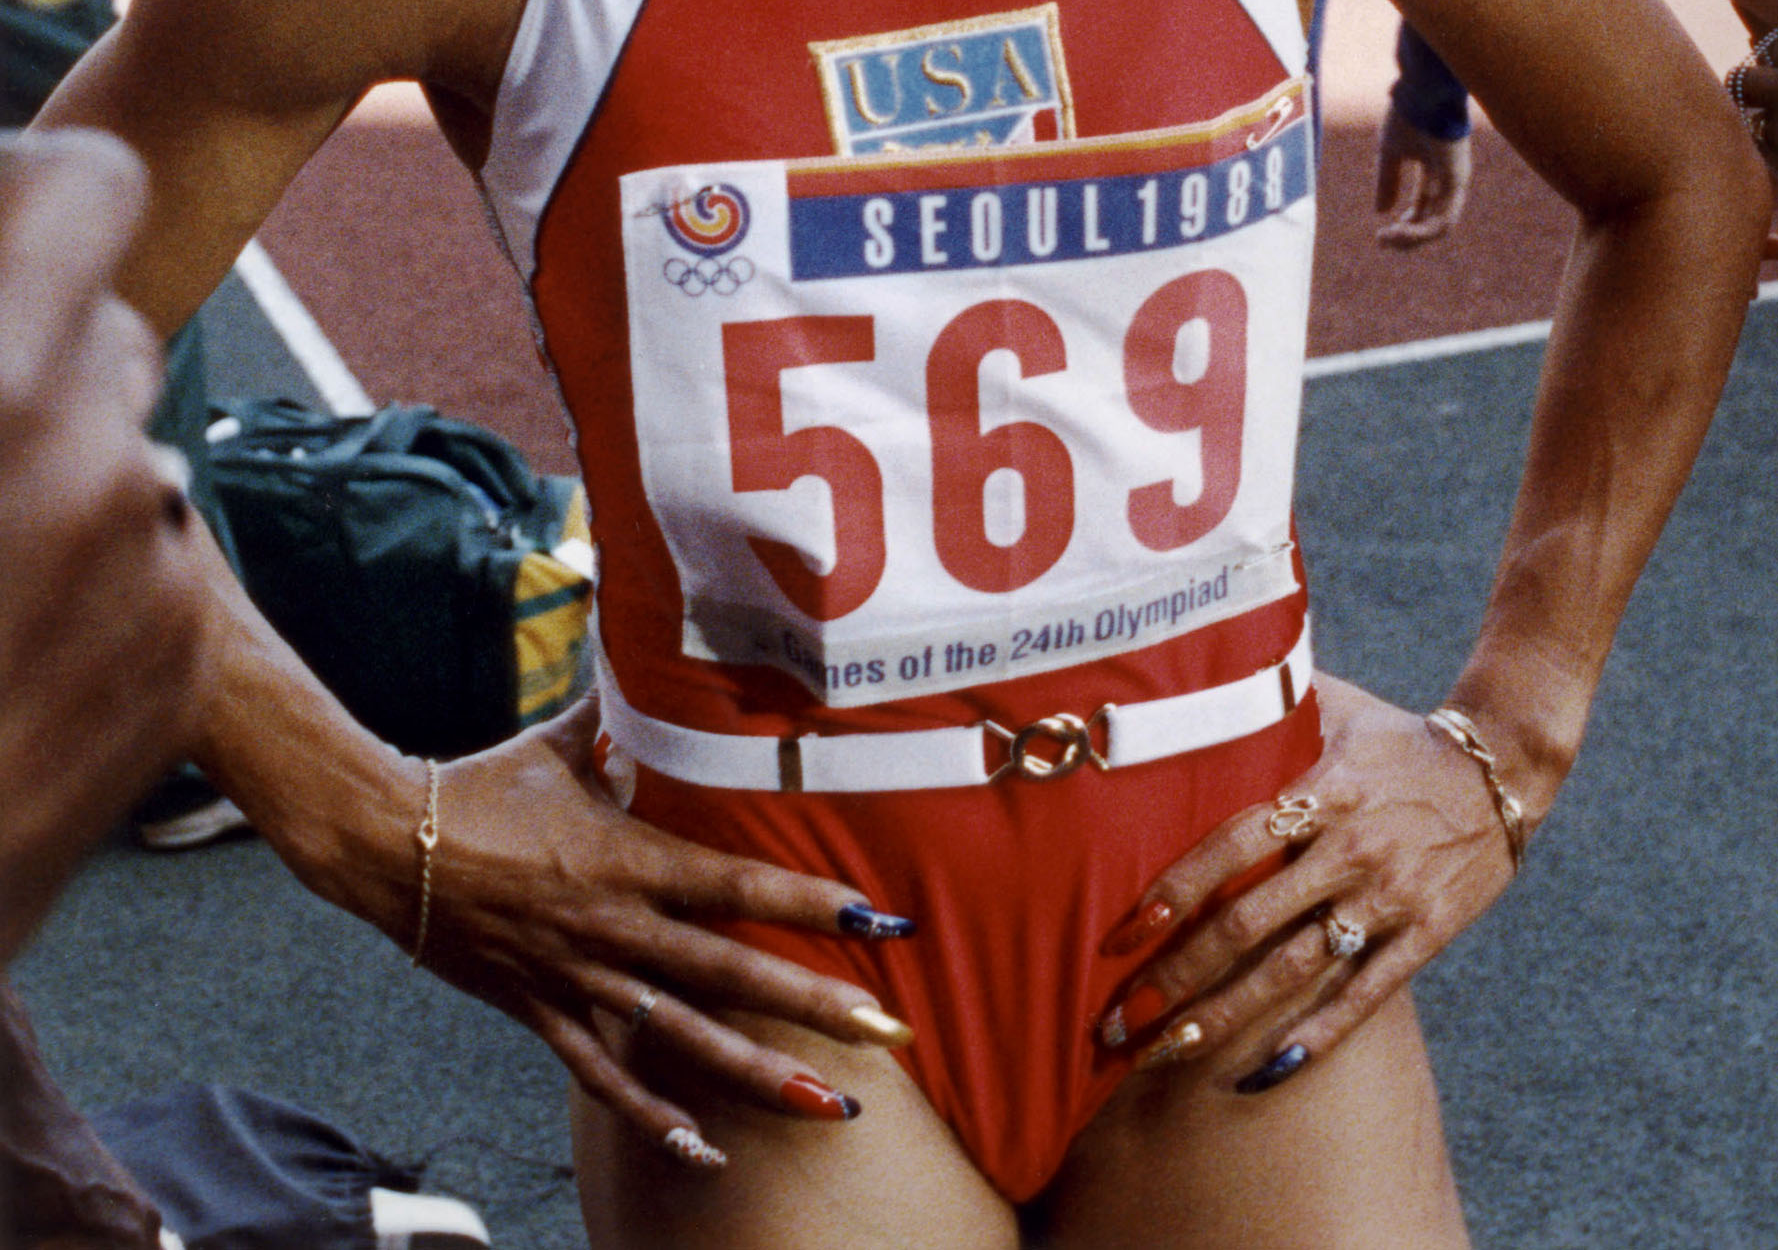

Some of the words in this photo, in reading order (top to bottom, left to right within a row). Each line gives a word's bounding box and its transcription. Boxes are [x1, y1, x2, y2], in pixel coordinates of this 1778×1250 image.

[843, 37, 1044, 126] USA
[862, 183, 1111, 269] SEOUL
[1136, 145, 1284, 246] 1988
[721, 268, 1249, 622] 569
[900, 645, 933, 682] of
[945, 641, 997, 673] the
[1010, 617, 1085, 662] 24th
[1093, 565, 1229, 641] Olympiad
